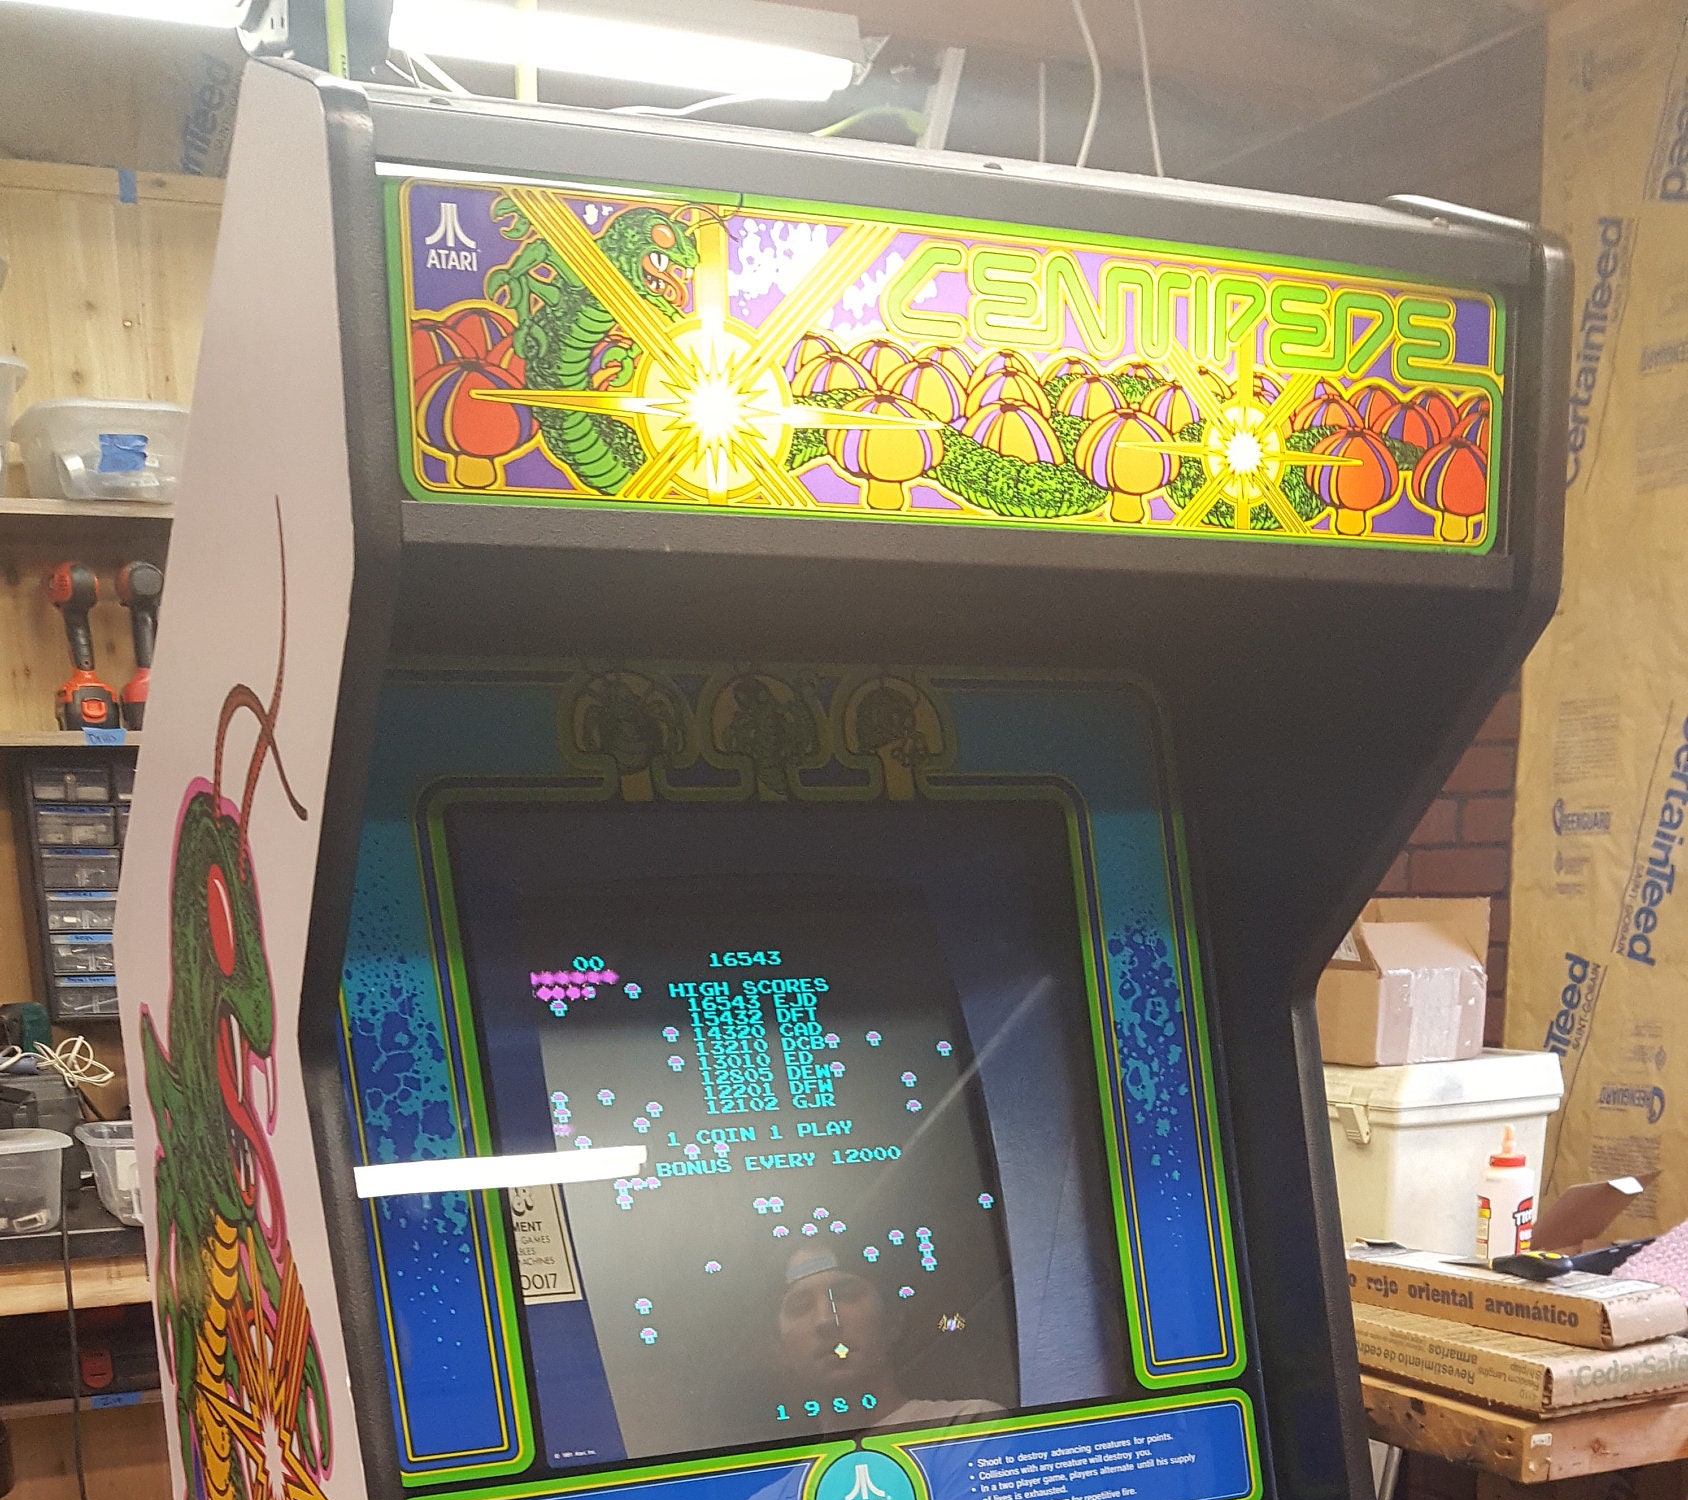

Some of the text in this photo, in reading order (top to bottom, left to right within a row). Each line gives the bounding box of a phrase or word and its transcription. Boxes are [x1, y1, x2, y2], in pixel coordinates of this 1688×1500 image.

[426, 249, 478, 272] ATARI
[884, 240, 1458, 388] CENTIPEDE
[572, 956, 605, 972] 00
[709, 951, 782, 968] 16543
[668, 977, 830, 998] HIGH SCORES
[688, 993, 817, 1012] 16543 EJD
[691, 1007, 817, 1027] 15432 DFT
[694, 1022, 823, 1041] 14320 CAD
[696, 1035, 826, 1056] 13210 DCB
[699, 1051, 814, 1070] 13010 ED
[701, 1064, 831, 1086] 12805 DEW
[704, 1079, 834, 1100] 12201 DFW
[707, 1093, 836, 1114] 12102 GJR
[667, 1120, 853, 1147] 1 COIN 1 PLAY
[656, 1146, 902, 1178] BONUS EVERY 12000
[1408, 1281, 1474, 1310] oriental
[1485, 1300, 1579, 1329] aromático
[1383, 1348, 1396, 1361] de
[1428, 1343, 1478, 1366] armarios
[1398, 1352, 1476, 1386] Revestimiento
[977, 1432, 1173, 1468] Shoot to destroy advancing creatures for points.
[978, 1449, 1152, 1481] Collisions with any creature will destroy you.
[980, 1484, 989, 1493] In
[998, 1481, 1015, 1490] two
[1016, 1477, 1041, 1489] player
[1069, 1468, 1099, 1481] players
[1099, 1462, 1134, 1475] alternate
[1137, 1459, 1155, 1470] until
[1156, 1457, 1168, 1466] his
[1170, 1453, 1196, 1465] supply
[1014, 1491, 1022, 1500] is
[1024, 1485, 1068, 1499] exhausted.
[1122, 1487, 1137, 1497] fire.
